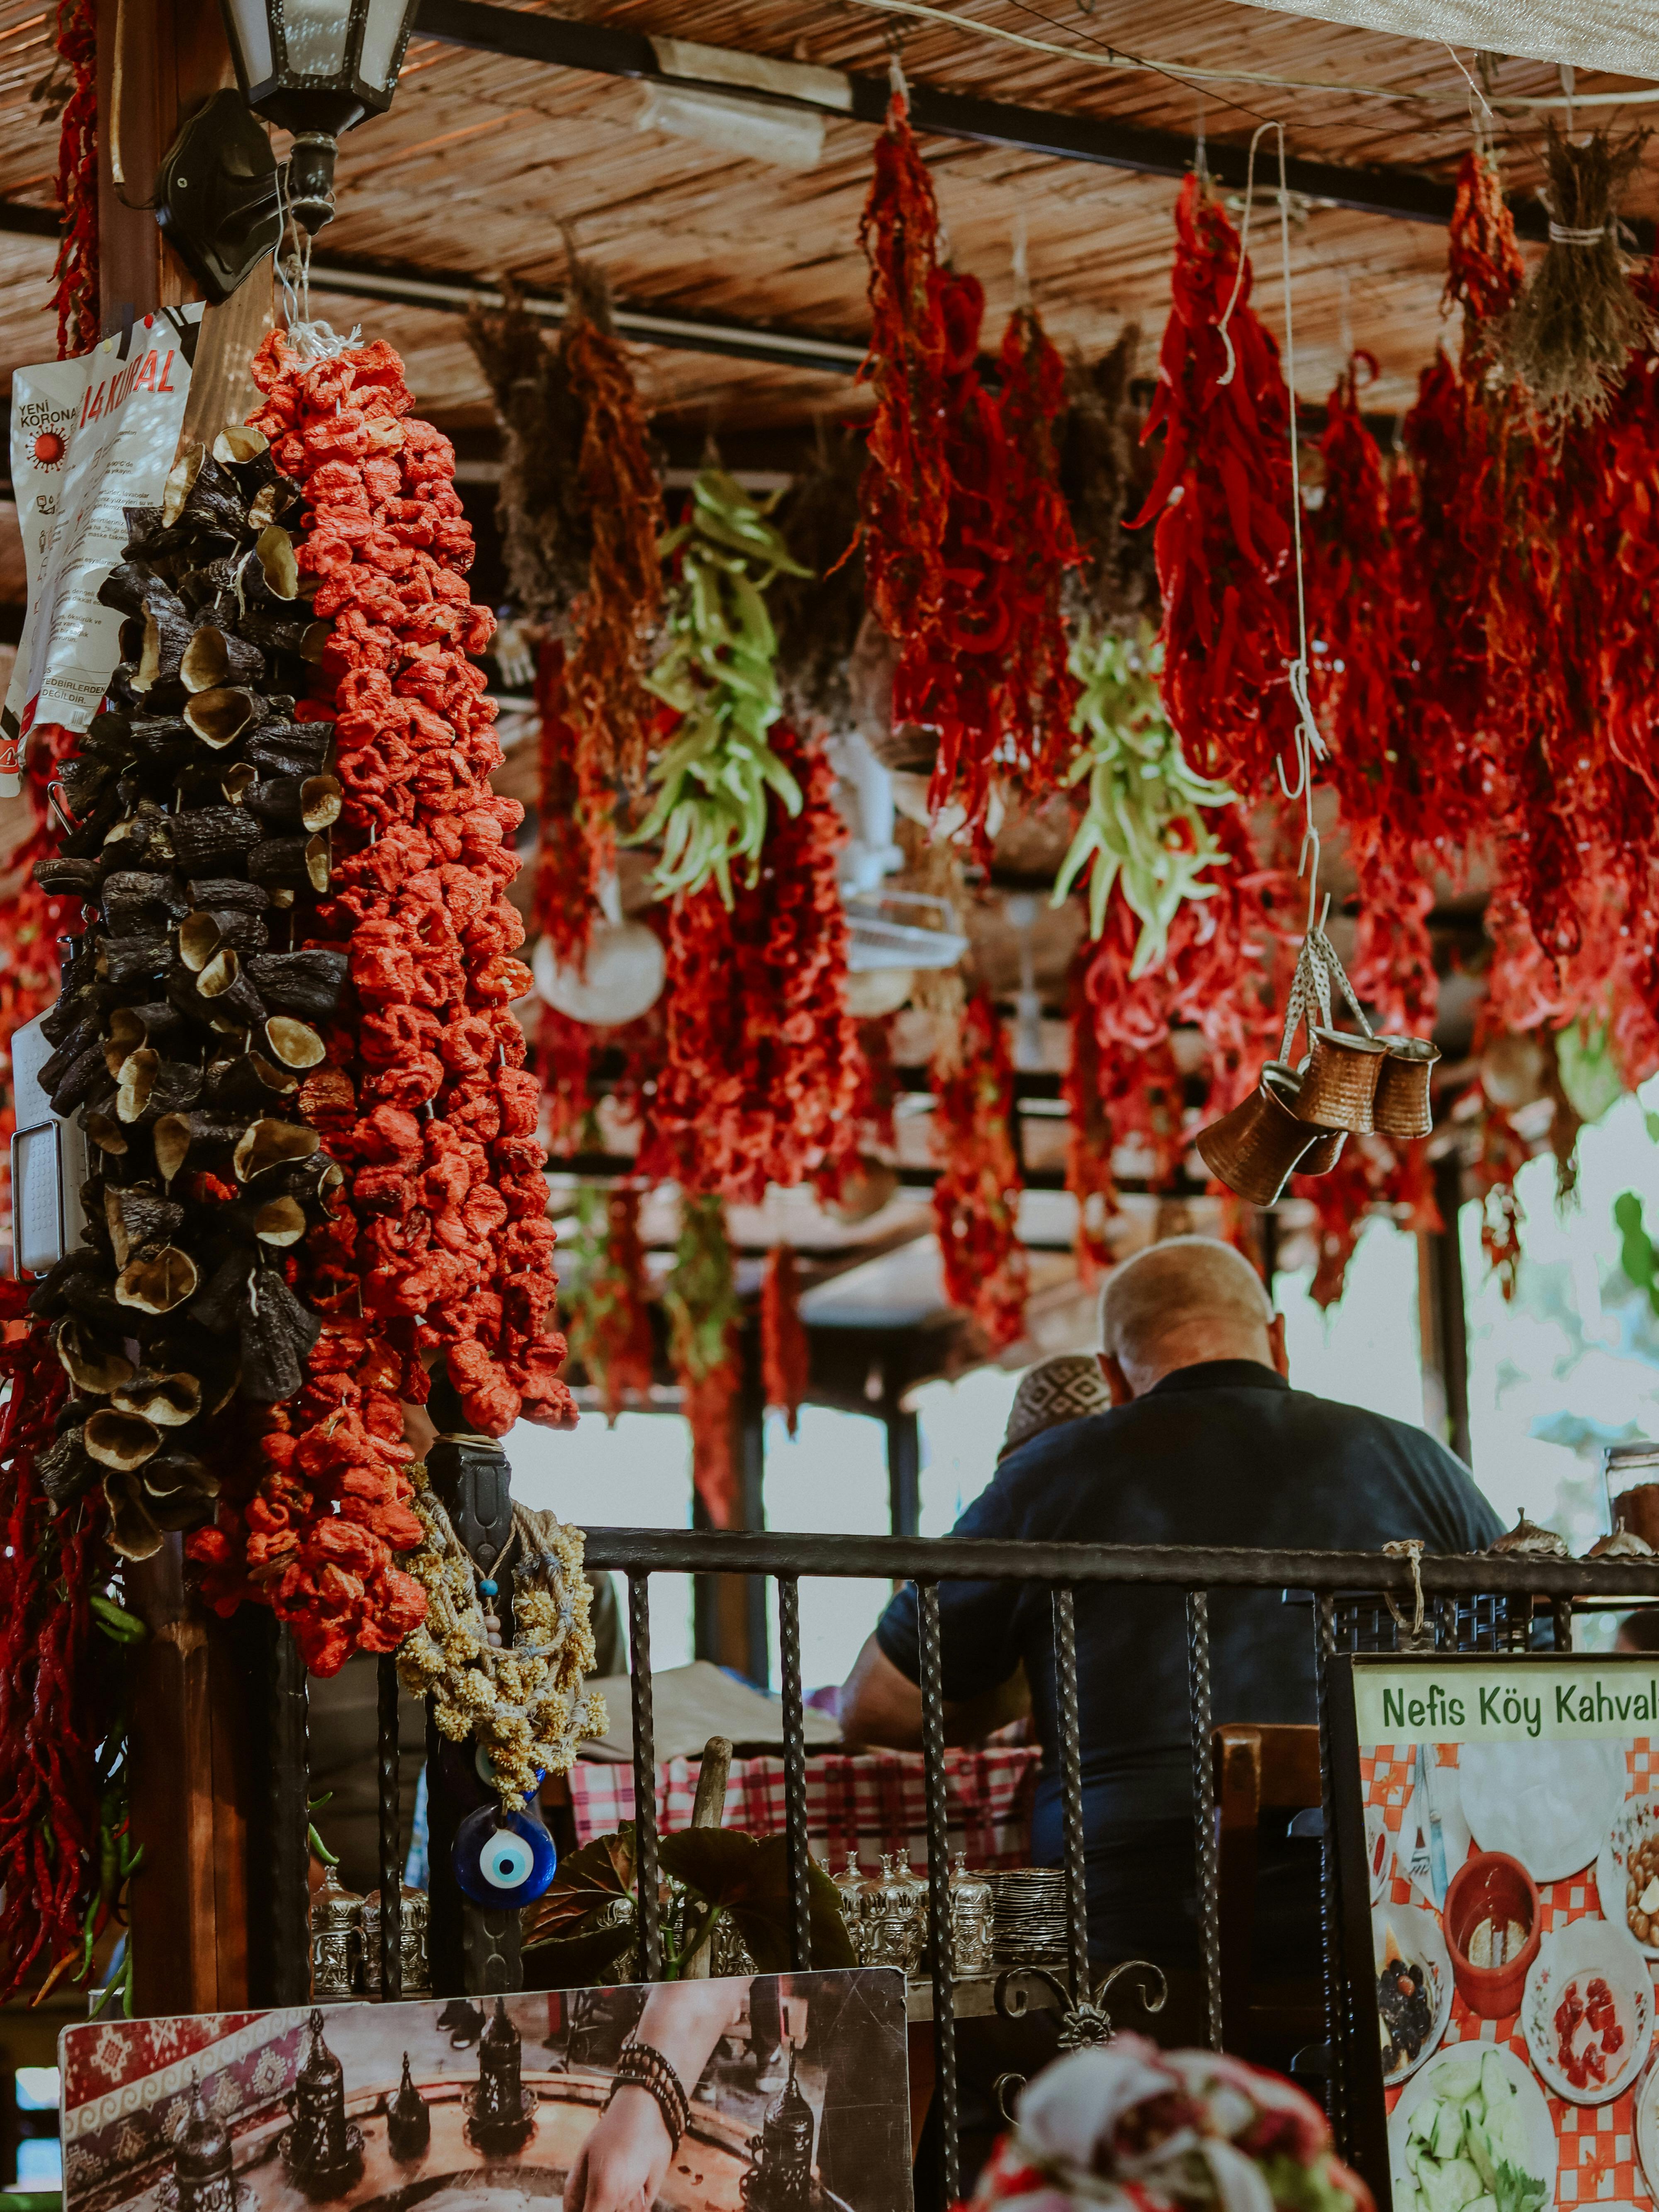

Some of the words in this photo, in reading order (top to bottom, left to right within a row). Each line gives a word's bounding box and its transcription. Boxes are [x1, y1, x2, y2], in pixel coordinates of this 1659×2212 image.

[19, 399, 49, 416] YENİ
[21, 407, 78, 428] KORONA
[72, 589, 95, 597] dengeli
[68, 613, 93, 623] öksürük
[42, 689, 86, 704] DEĞİLDİR.
[1383, 1684, 1465, 1727] Nefis
[1479, 1686, 1542, 1737] Köy
[1555, 1680, 1659, 1723] Kahval
